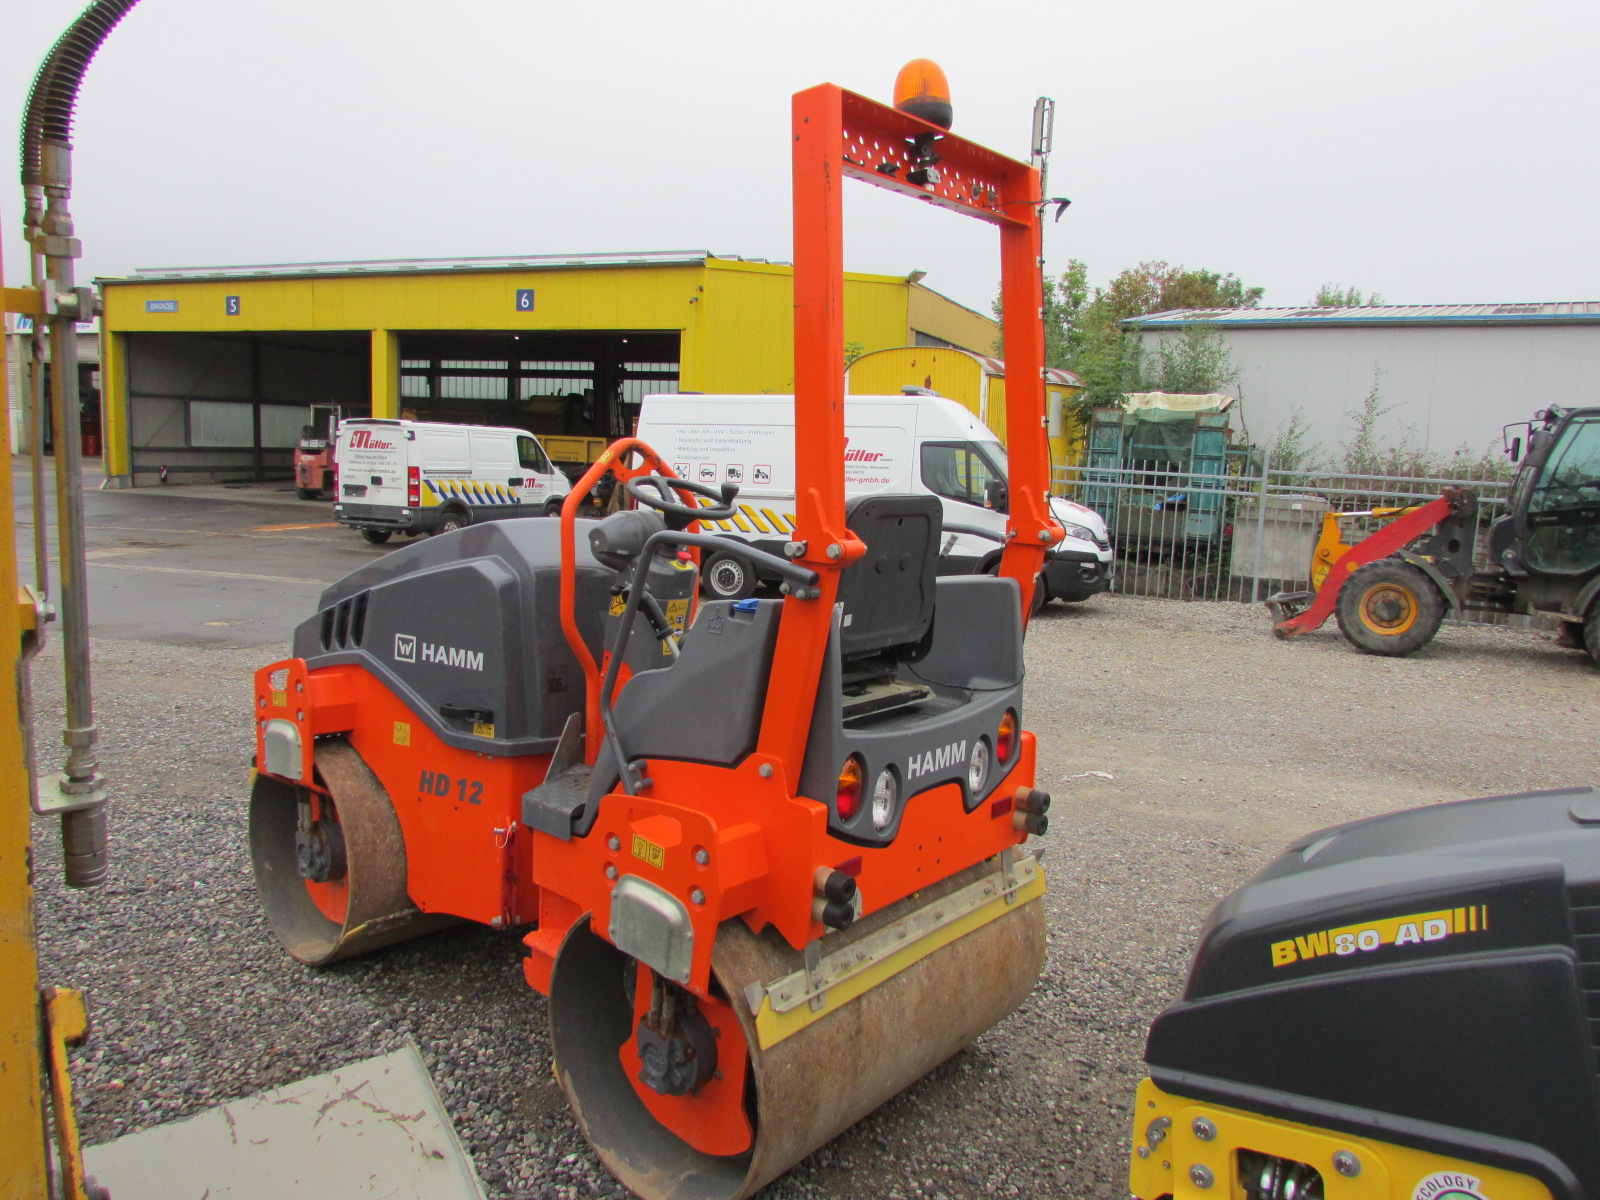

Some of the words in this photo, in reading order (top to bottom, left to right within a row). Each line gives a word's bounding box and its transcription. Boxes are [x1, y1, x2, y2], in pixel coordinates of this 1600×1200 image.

[230, 299, 237, 313] 5
[521, 292, 530, 309] 6
[844, 437, 884, 462] üller
[422, 642, 484, 672] HAMM
[908, 740, 966, 780] HAMM
[419, 770, 450, 797] HD
[457, 778, 484, 806] 12
[1395, 918, 1448, 946] AD
